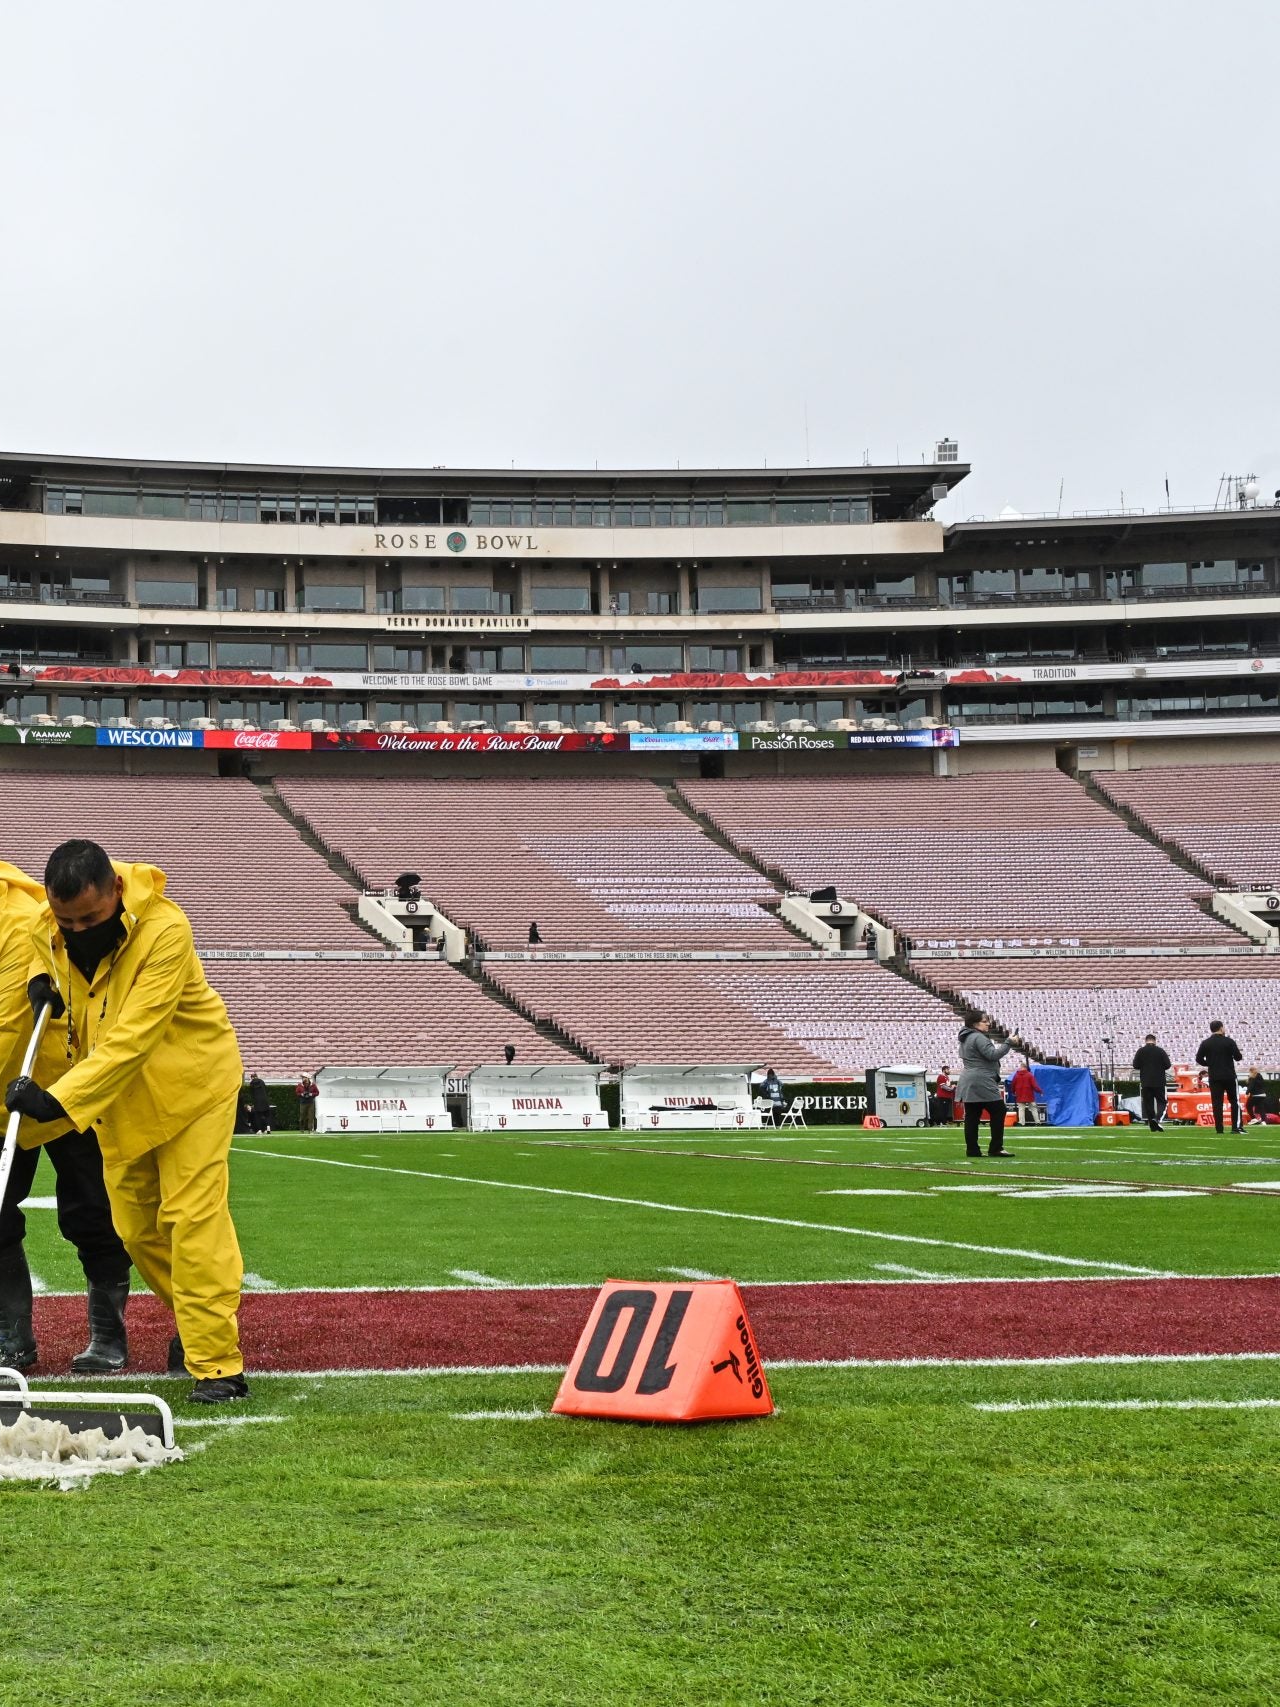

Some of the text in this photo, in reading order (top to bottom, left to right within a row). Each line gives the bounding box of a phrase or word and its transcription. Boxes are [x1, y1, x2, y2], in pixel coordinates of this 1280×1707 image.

[374, 534, 538, 550] ROSE BOWL
[387, 617, 529, 628] TERRY DONAHUE PAVILION
[1032, 668, 1076, 679] TRADITION
[362, 675, 493, 686] WELCOME TO THE ROSE BOWL GAME
[108, 730, 176, 746] WESCOM
[234, 731, 278, 748] Coca-Cola
[377, 734, 565, 750] Welcome to the Rose Bowl
[752, 736, 835, 749] Passion Roses
[876, 735, 892, 743] GIVES
[408, 903, 416, 912] 19
[832, 904, 840, 912] 18
[1269, 899, 1277, 907] 17
[356, 1100, 407, 1111] INDIANA
[512, 1098, 563, 1110] INDIANA
[1171, 1102, 1178, 1113] G
[869, 1118, 880, 1128] 40
[1200, 1115, 1215, 1125] 50
[574, 1290, 693, 1395] 10
[736, 1314, 764, 1399] Gilman
